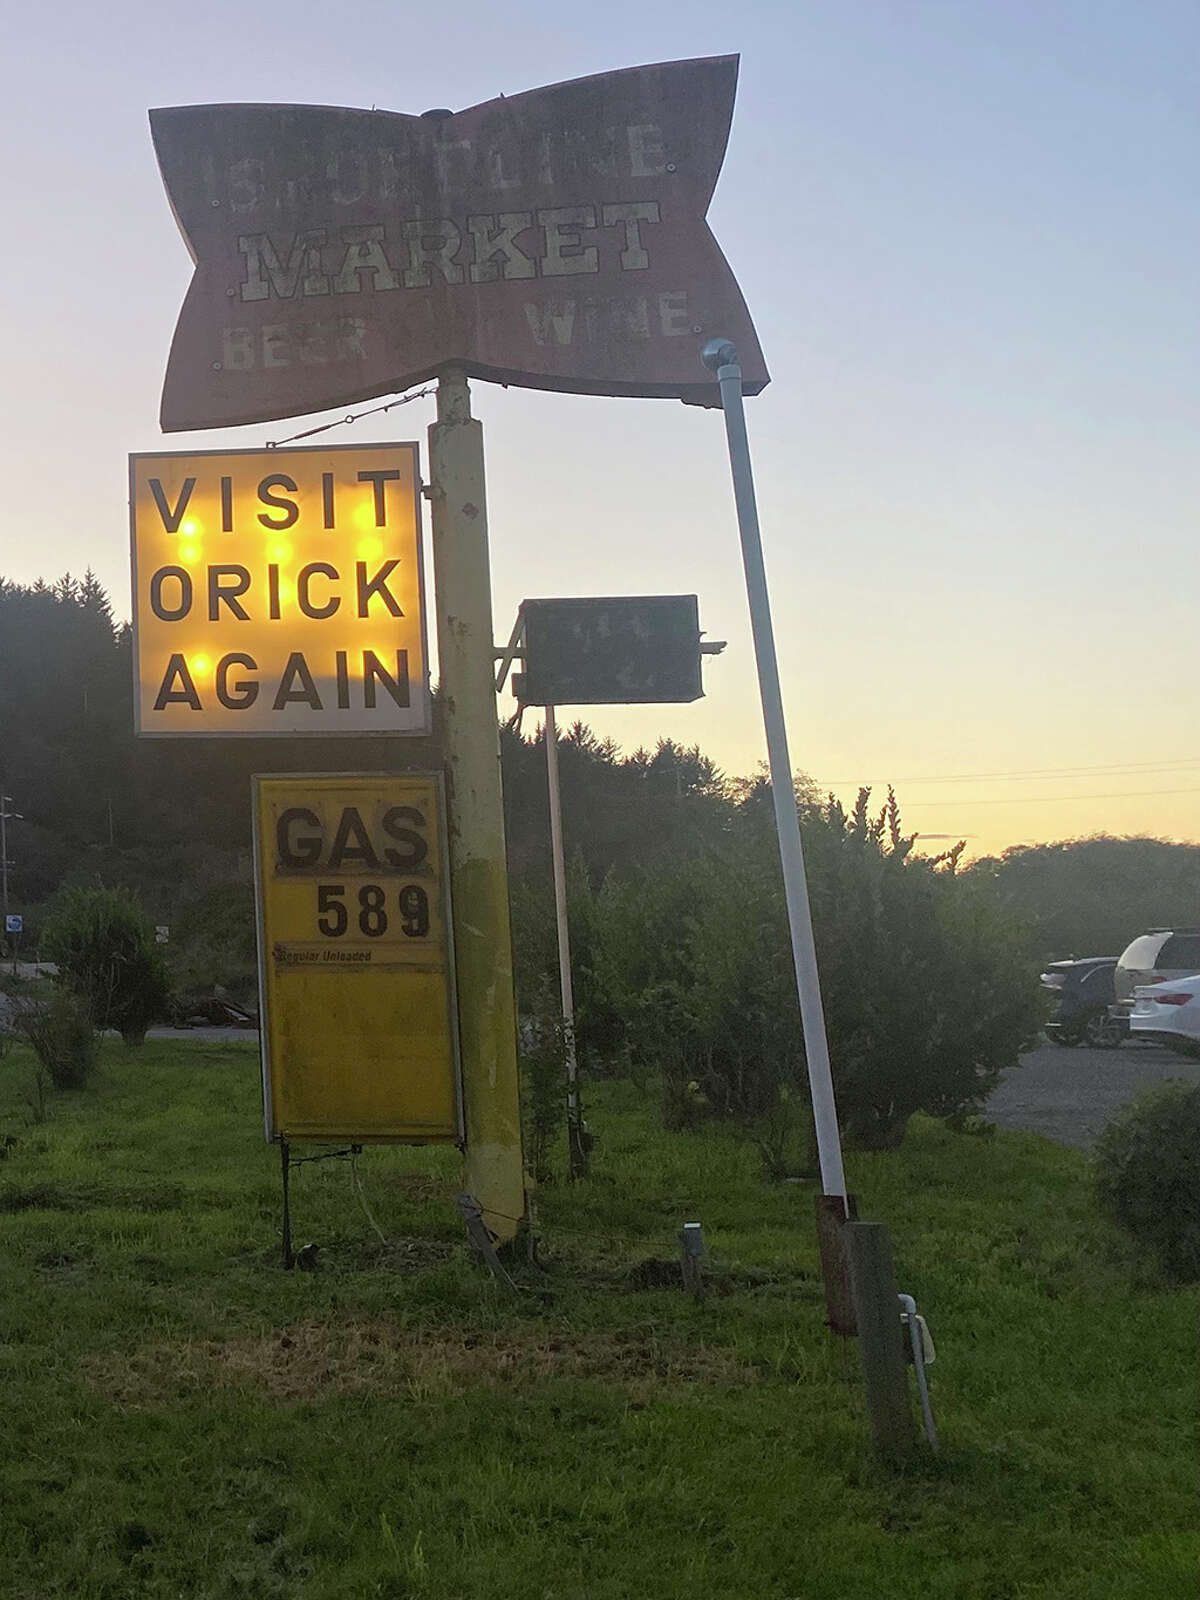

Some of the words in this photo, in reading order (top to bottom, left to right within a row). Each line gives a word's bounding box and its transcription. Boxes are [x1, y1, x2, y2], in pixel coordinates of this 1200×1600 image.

[237, 201, 662, 303] MARKET
[148, 470, 400, 534] VISIT
[150, 560, 405, 622] ORICK
[153, 649, 411, 711] AGAIN
[276, 806, 429, 868] GAS
[318, 884, 430, 938] 589
